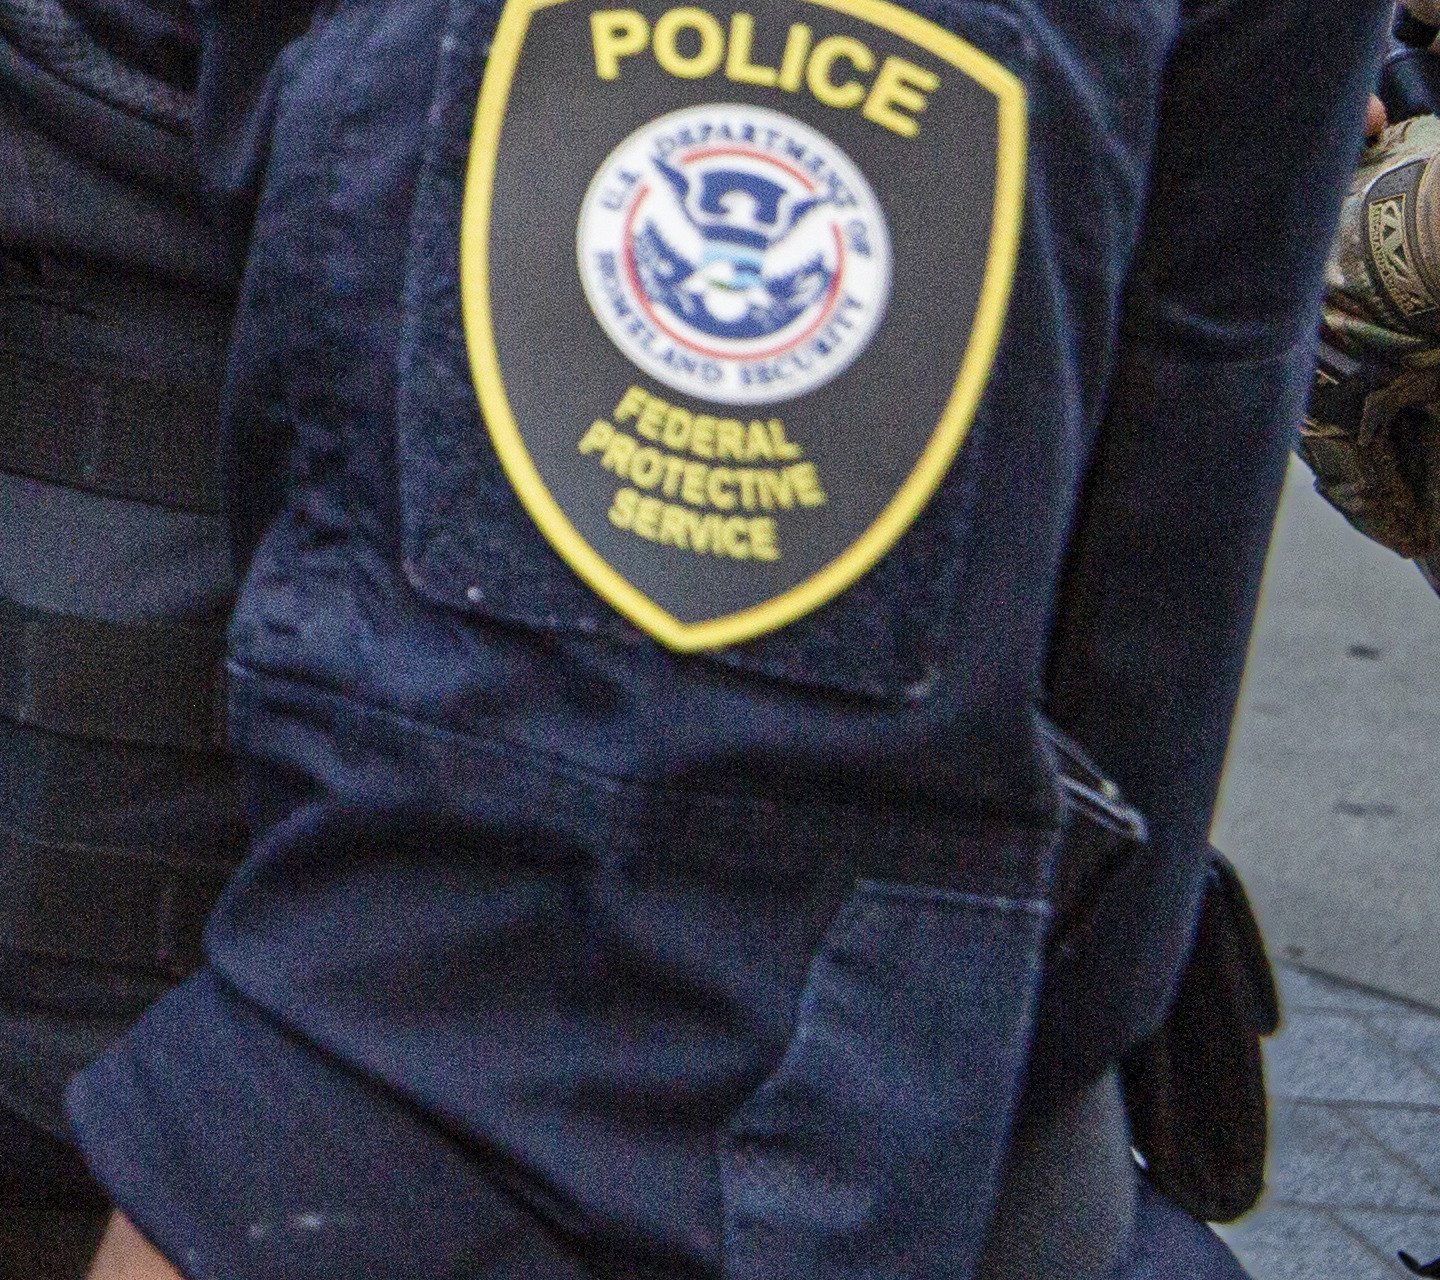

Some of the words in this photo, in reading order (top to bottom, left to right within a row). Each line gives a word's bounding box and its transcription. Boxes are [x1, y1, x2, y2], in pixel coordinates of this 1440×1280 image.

[589, 5, 941, 139] POLICE
[653, 122, 856, 209] DEPARTMENT
[848, 216, 874, 260] OF
[596, 248, 724, 386] HOMELAND
[738, 295, 868, 388] SECURITY
[577, 419, 828, 508] PROTECTIVE
[613, 386, 803, 461] FEDERAL
[607, 486, 781, 563] SERVICE
